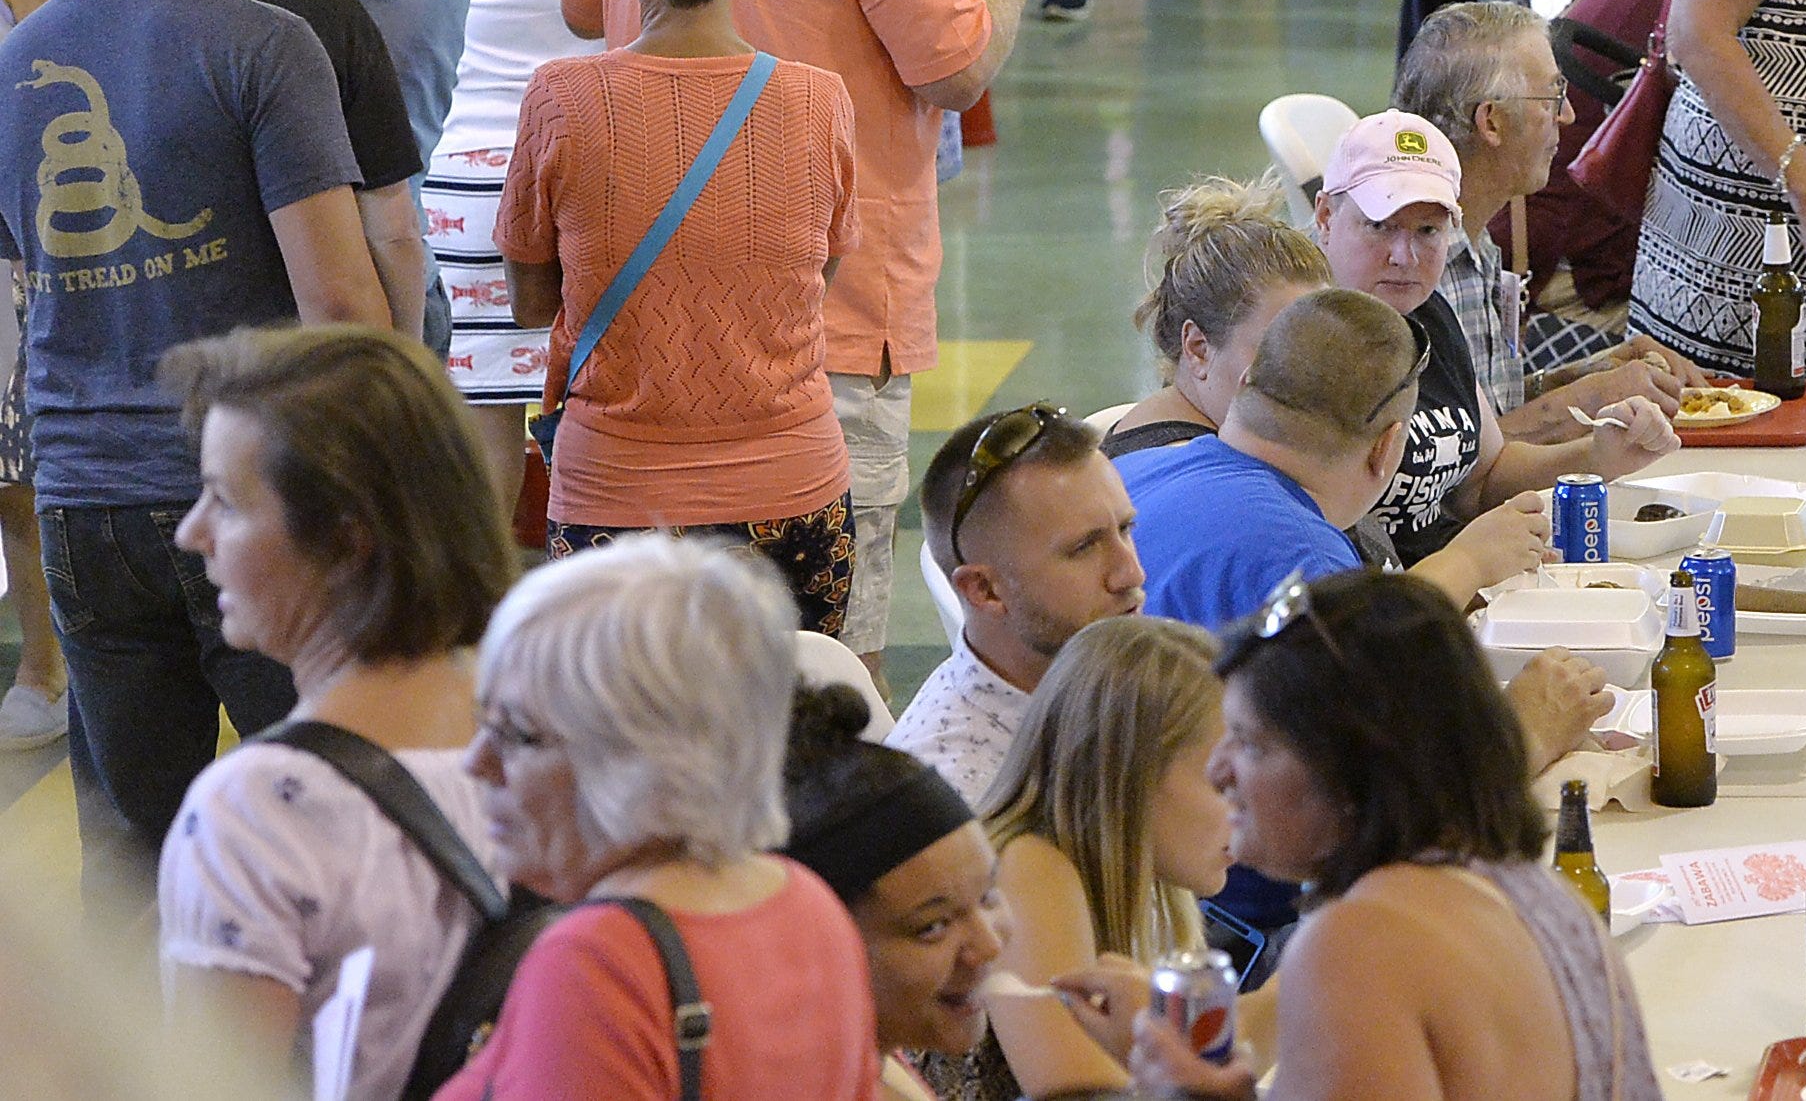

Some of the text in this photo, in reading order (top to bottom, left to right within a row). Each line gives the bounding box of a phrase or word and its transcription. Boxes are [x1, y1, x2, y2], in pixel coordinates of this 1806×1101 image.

[1384, 155, 1442, 167] JOHN DEERE
[28, 237, 229, 294] OT TREAD ON ME
[1457, 407, 1476, 433] A
[1580, 500, 1601, 563] pepsi
[1695, 576, 1715, 641] pepsi
[1689, 861, 1718, 908] ZABAWA
